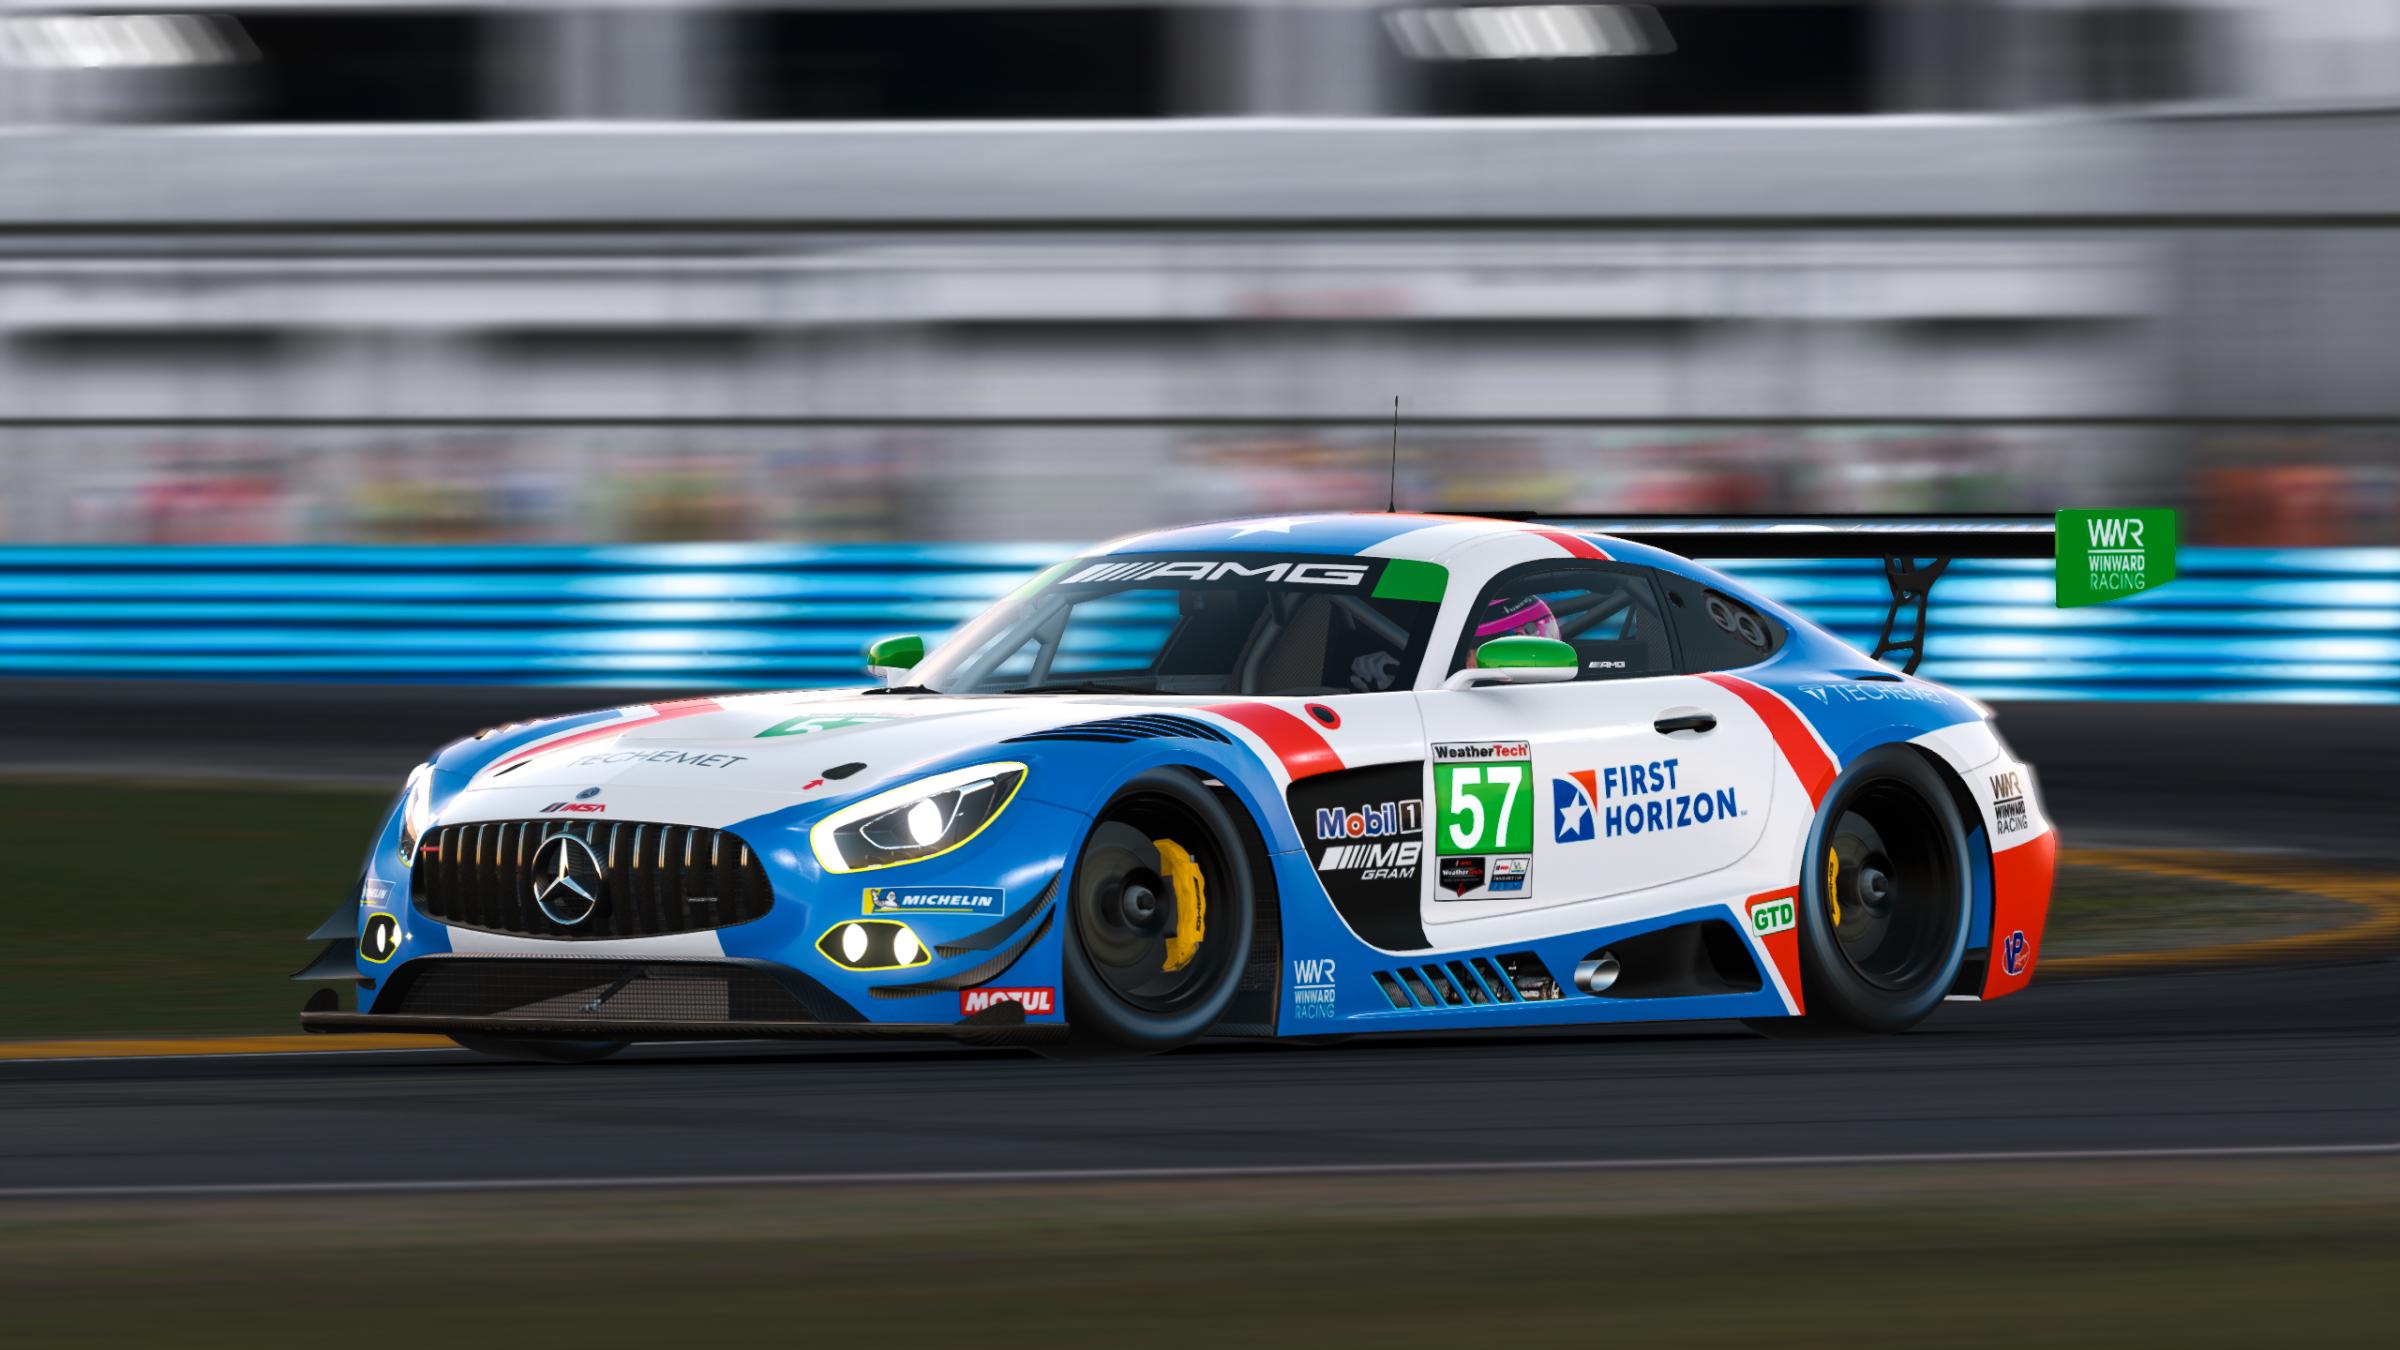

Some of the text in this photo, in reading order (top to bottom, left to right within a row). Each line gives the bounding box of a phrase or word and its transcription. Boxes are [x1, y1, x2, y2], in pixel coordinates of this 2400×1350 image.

[2088, 555, 2145, 572] WINWARD
[1135, 561, 1370, 586] AMG
[2090, 572, 2145, 590] RACING
[567, 750, 748, 769] TECHEMET
[1435, 745, 1528, 759] WeatherTech
[1603, 758, 1678, 799] FIRST
[1449, 766, 1523, 850] 57
[1605, 787, 1738, 838] HORIZON
[1994, 800, 2026, 820] WINWARD
[1316, 802, 1398, 839] Mobil
[1997, 814, 2028, 835] RACING
[1361, 866, 1416, 880] GRAM
[901, 895, 993, 906] MICHELIN
[1754, 904, 1793, 930] GTD
[1294, 989, 1336, 1004] WINWARD
[1295, 1003, 1335, 1019] RACING
